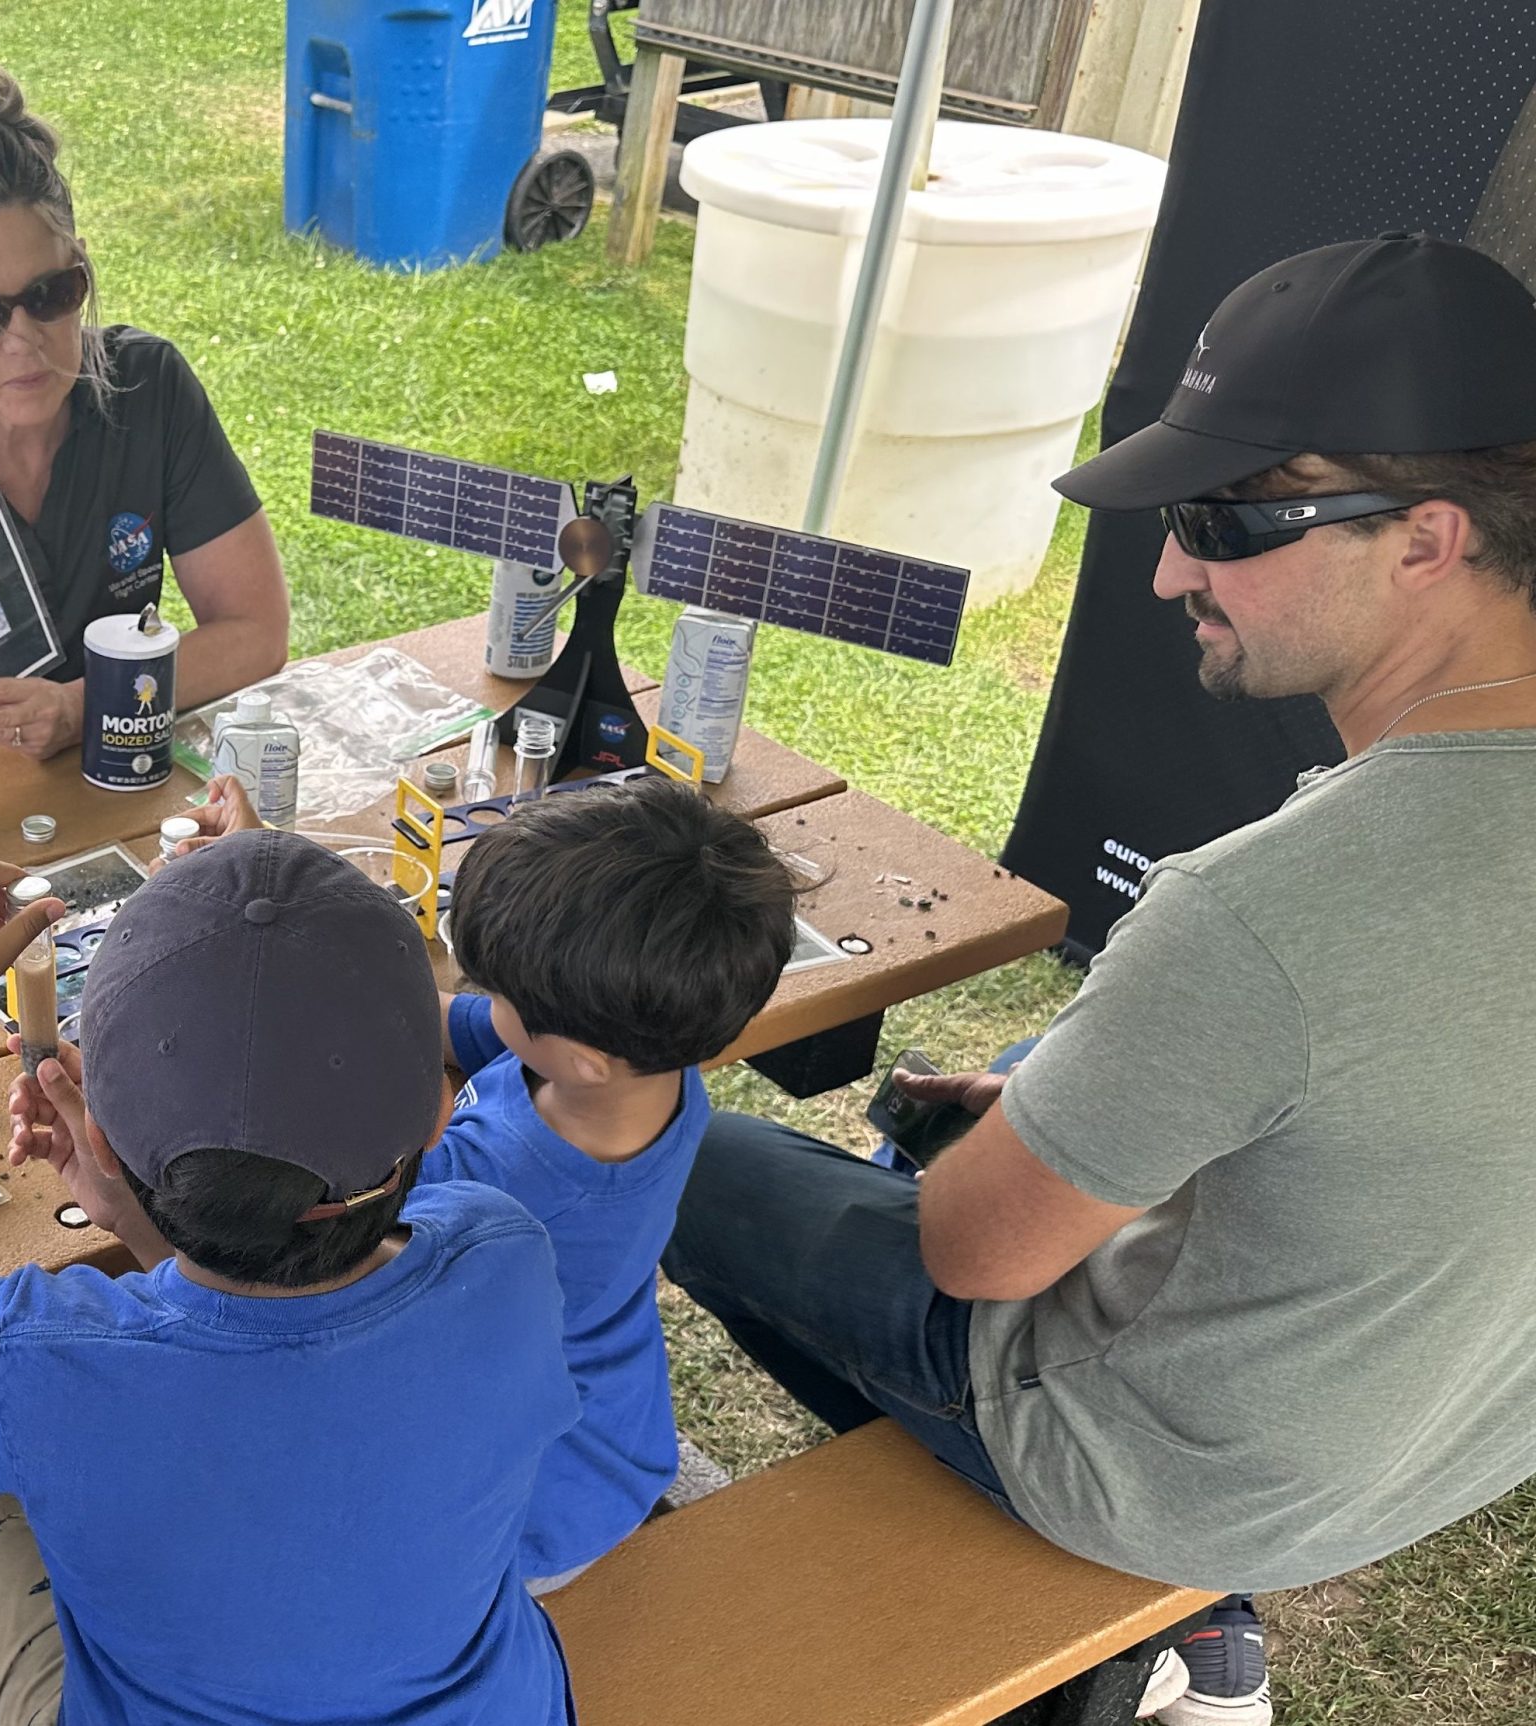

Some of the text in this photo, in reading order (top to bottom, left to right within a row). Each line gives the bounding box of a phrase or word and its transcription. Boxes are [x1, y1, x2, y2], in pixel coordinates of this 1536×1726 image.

[108, 531, 149, 559] NASA
[102, 710, 173, 734] MORTON
[599, 722, 626, 735] NASA
[102, 733, 153, 746] IODIZED
[592, 751, 626, 768] JPL
